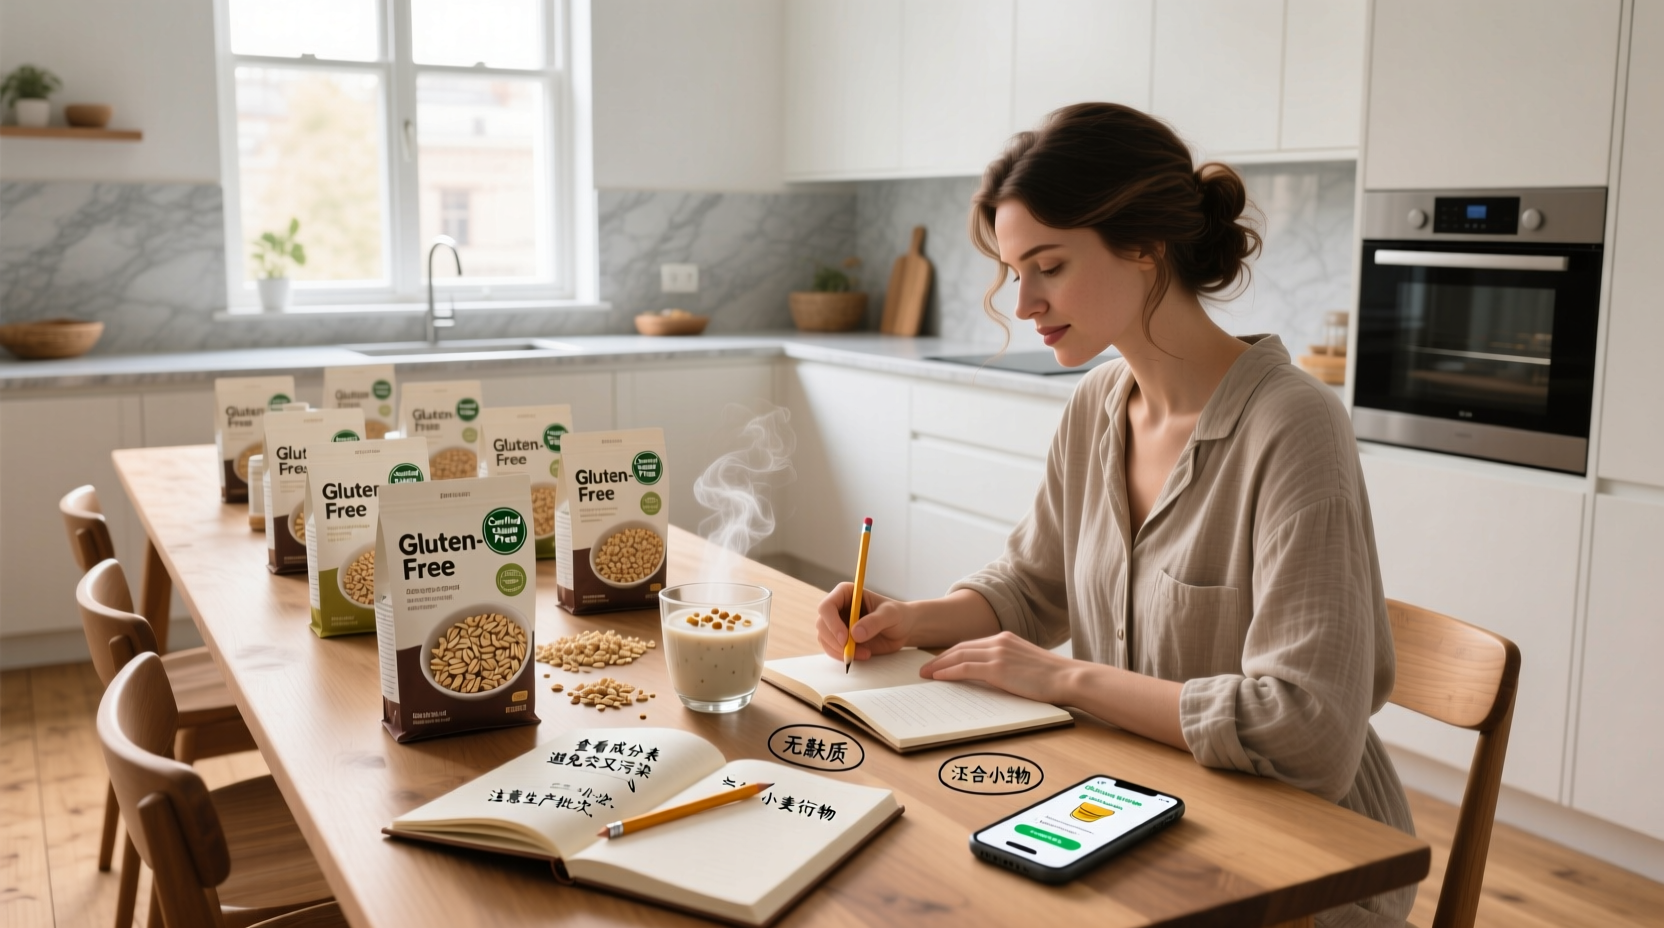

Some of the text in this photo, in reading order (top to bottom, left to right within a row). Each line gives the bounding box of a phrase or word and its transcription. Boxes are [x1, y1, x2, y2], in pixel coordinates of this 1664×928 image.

[493, 438, 544, 452] Gluten-
[276, 446, 307, 460] Glut
[496, 453, 527, 466] Free
[575, 469, 634, 485] Gluten-
[578, 488, 615, 502] Free
[325, 503, 367, 519] Free
[399, 532, 483, 556] Gluten-
[403, 558, 455, 580] Free
